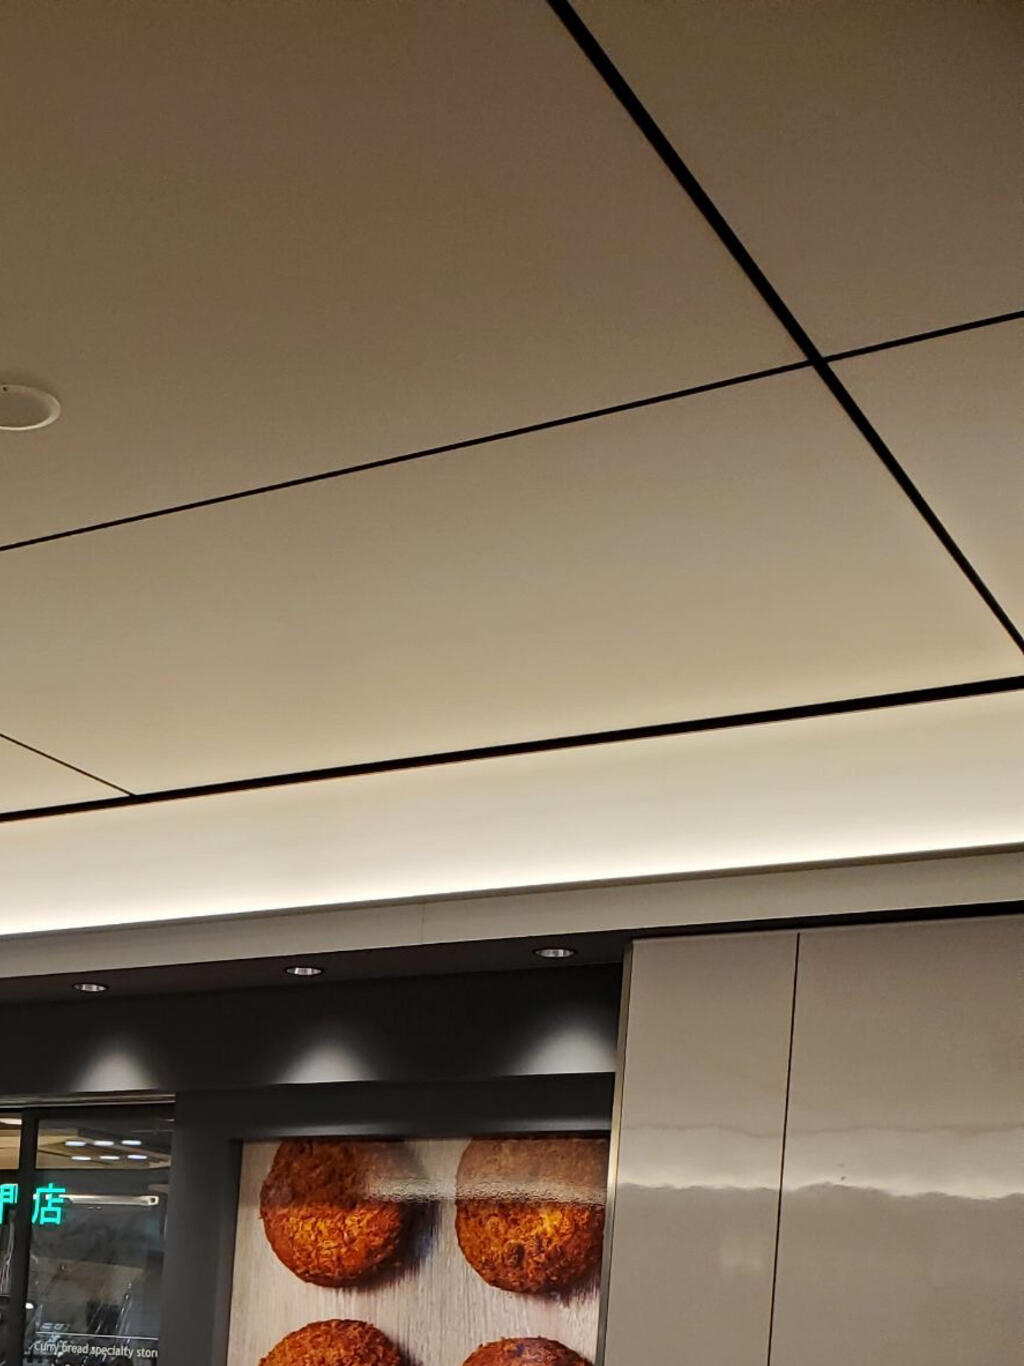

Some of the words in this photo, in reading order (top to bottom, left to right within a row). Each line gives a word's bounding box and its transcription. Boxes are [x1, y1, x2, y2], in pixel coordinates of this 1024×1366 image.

[34, 1340, 58, 1354] Curry
[62, 1340, 90, 1355] bread
[90, 1344, 135, 1359] specialty
